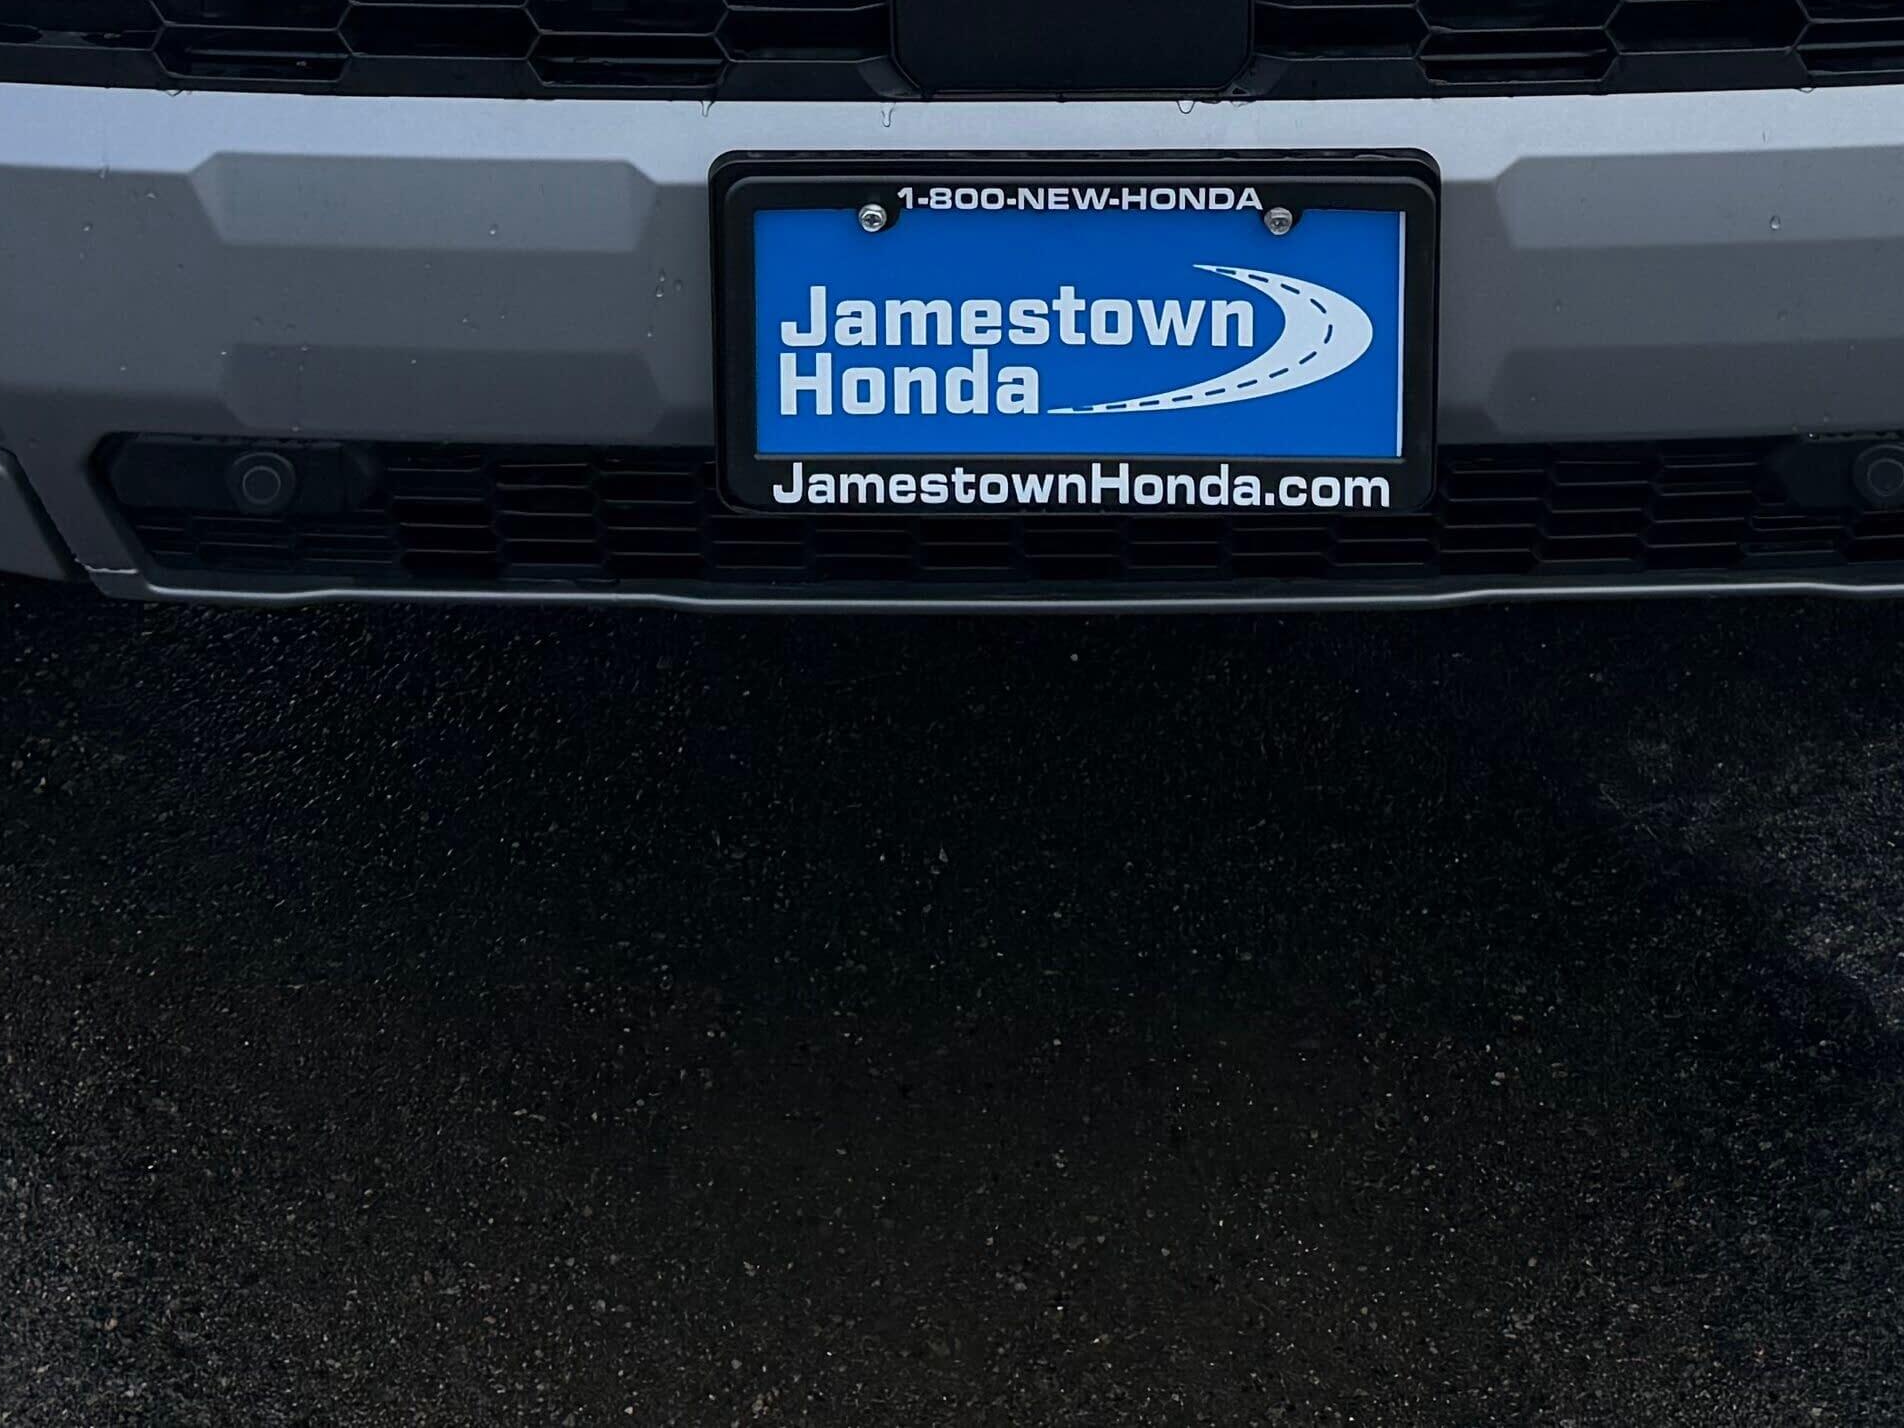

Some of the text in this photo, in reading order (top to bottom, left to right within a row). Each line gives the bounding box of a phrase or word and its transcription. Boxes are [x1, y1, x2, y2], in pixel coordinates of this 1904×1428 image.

[896, 186, 1264, 212] 1-800-NEW-HONDA
[780, 285, 1255, 348] Jamestown
[780, 349, 1040, 416] Honda
[773, 462, 1391, 508] JamestownHonda.com
